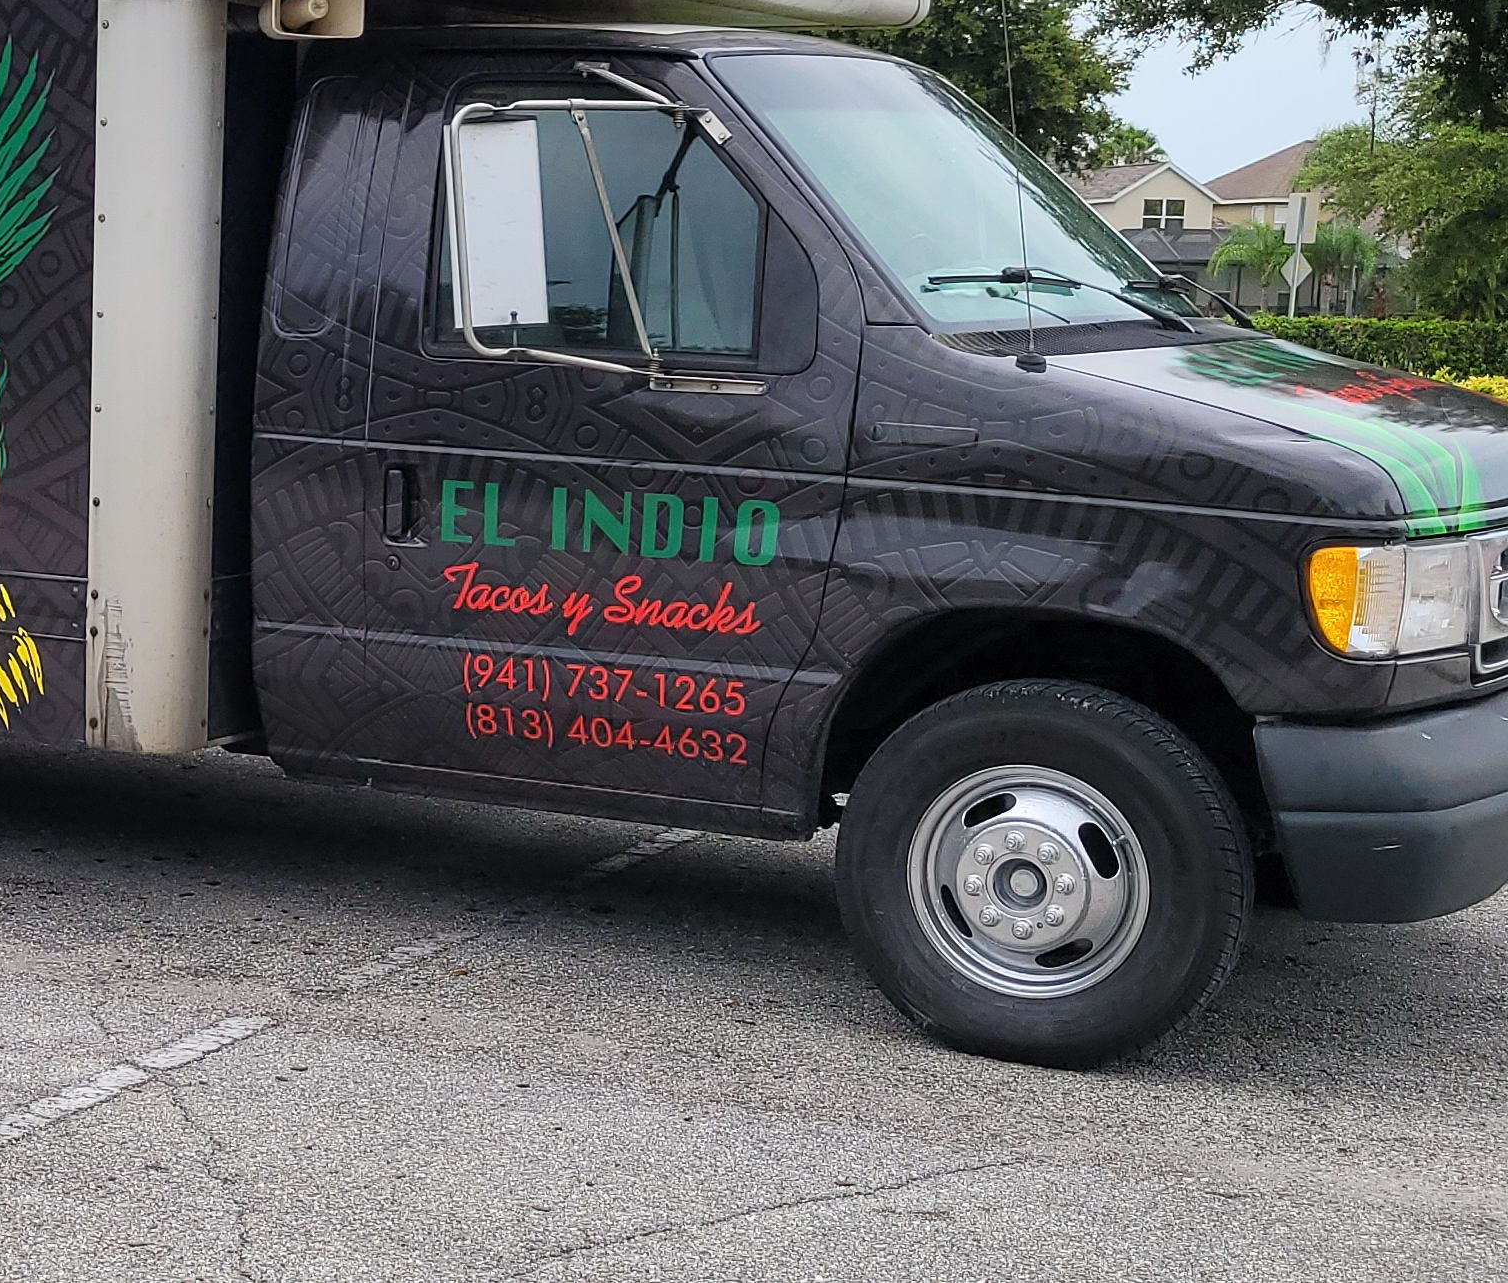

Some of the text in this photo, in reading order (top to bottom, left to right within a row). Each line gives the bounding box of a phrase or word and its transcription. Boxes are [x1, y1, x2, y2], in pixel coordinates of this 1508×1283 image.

[442, 479, 780, 566] EL INDIO
[444, 562, 762, 636] Tacos y Snacks
[463, 652, 746, 716] (941) 737-1265
[466, 701, 748, 765] (813) 404-4632
